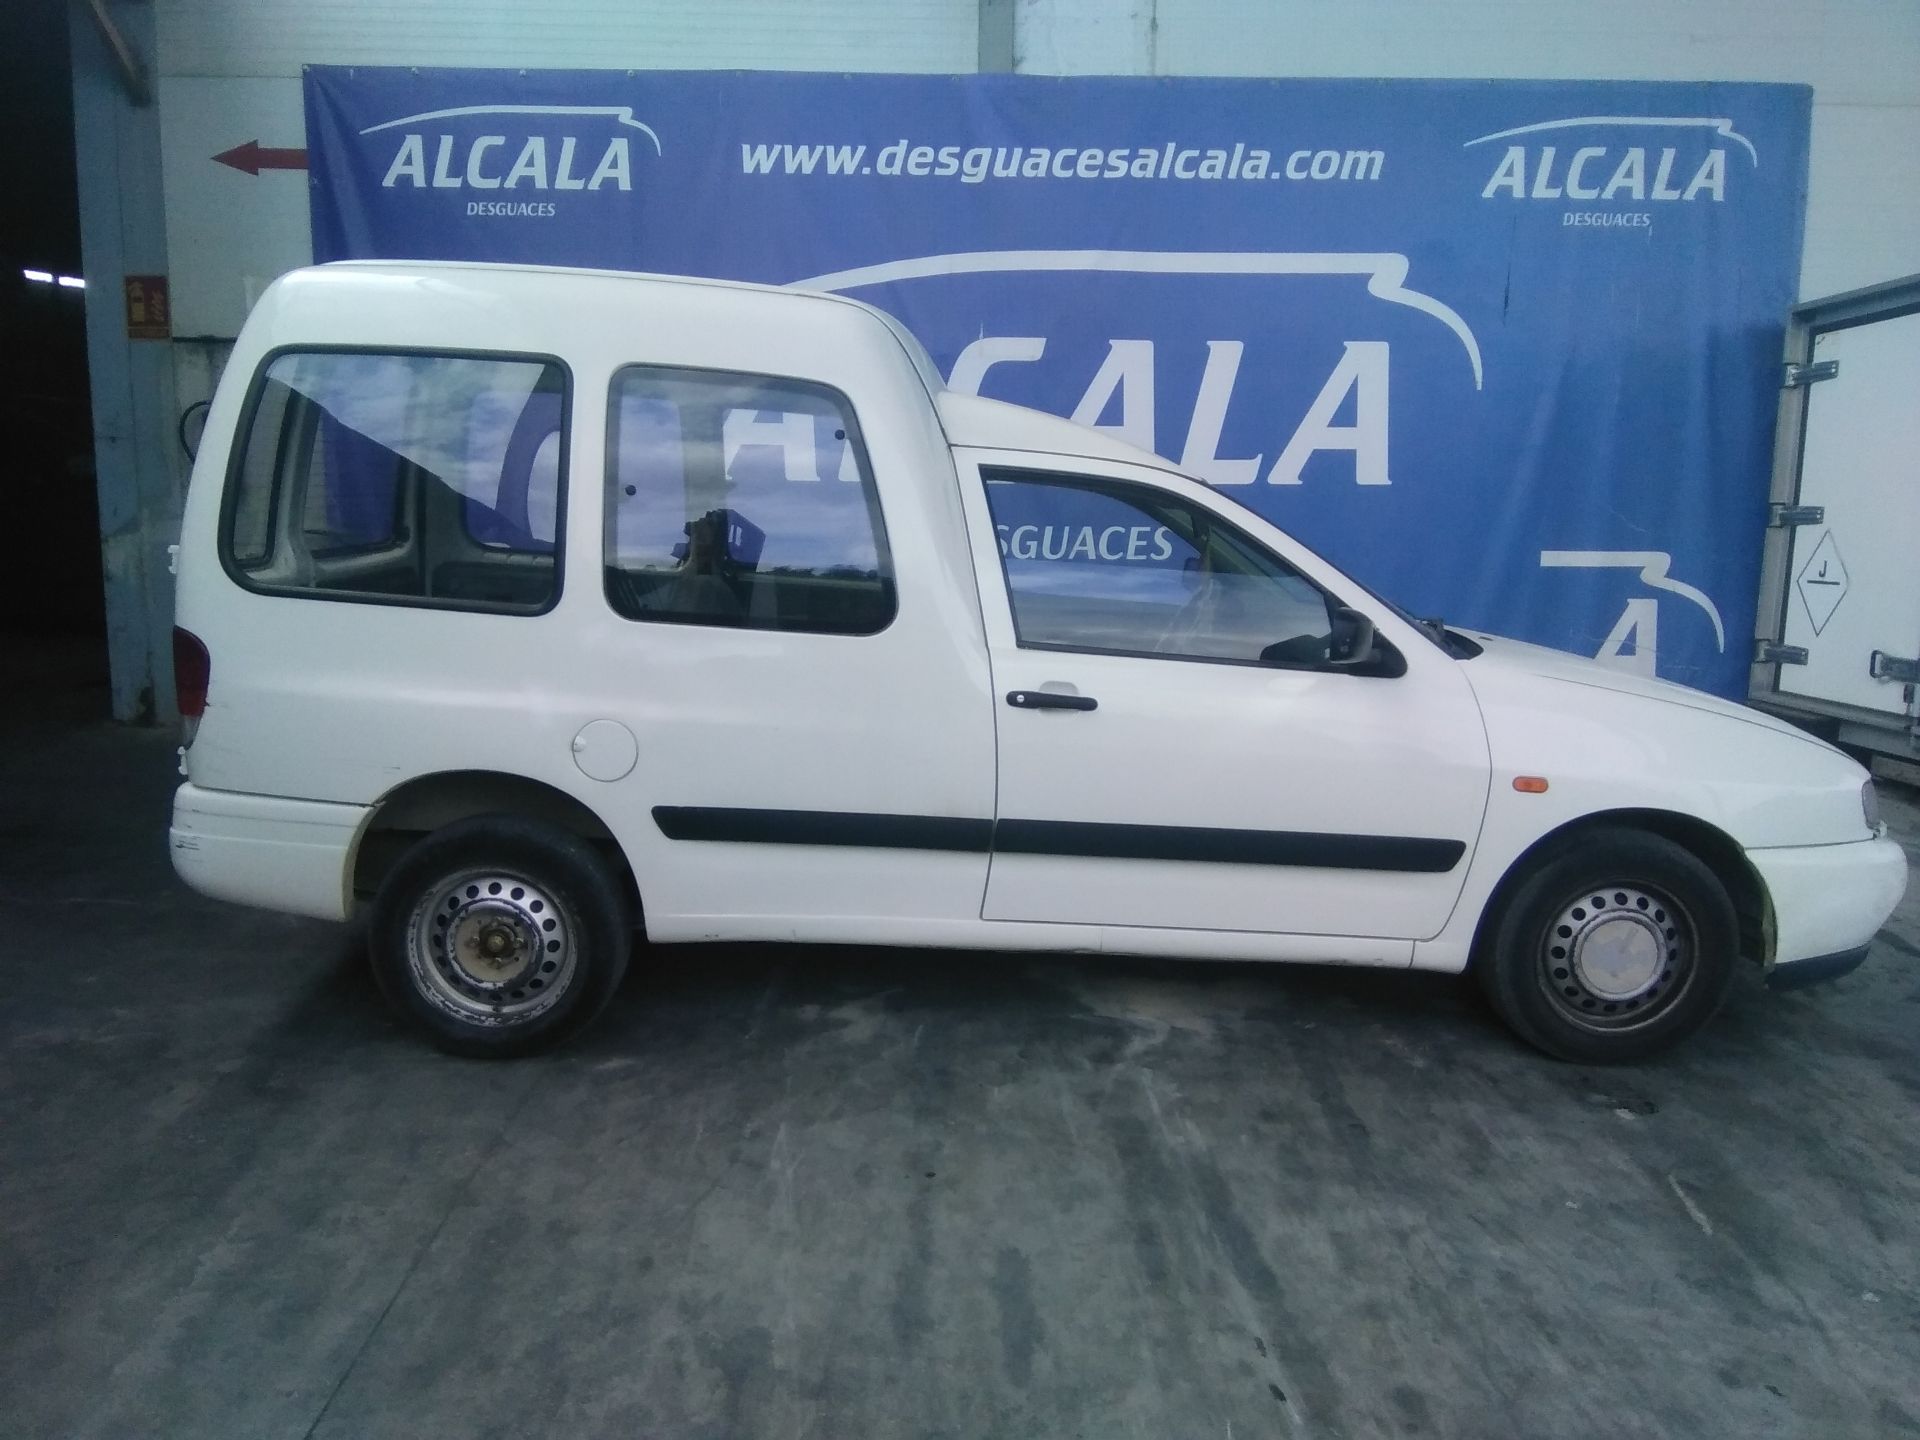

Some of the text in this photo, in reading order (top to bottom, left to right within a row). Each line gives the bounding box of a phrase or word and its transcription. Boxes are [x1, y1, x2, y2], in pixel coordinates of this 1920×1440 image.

[382, 134, 632, 191] ALCALA
[742, 139, 1385, 184] www.desguacesalcala.com
[1481, 146, 1726, 201] ALCALA
[466, 201, 556, 217] DESGUACES
[1562, 212, 1651, 228] DESGUACES
